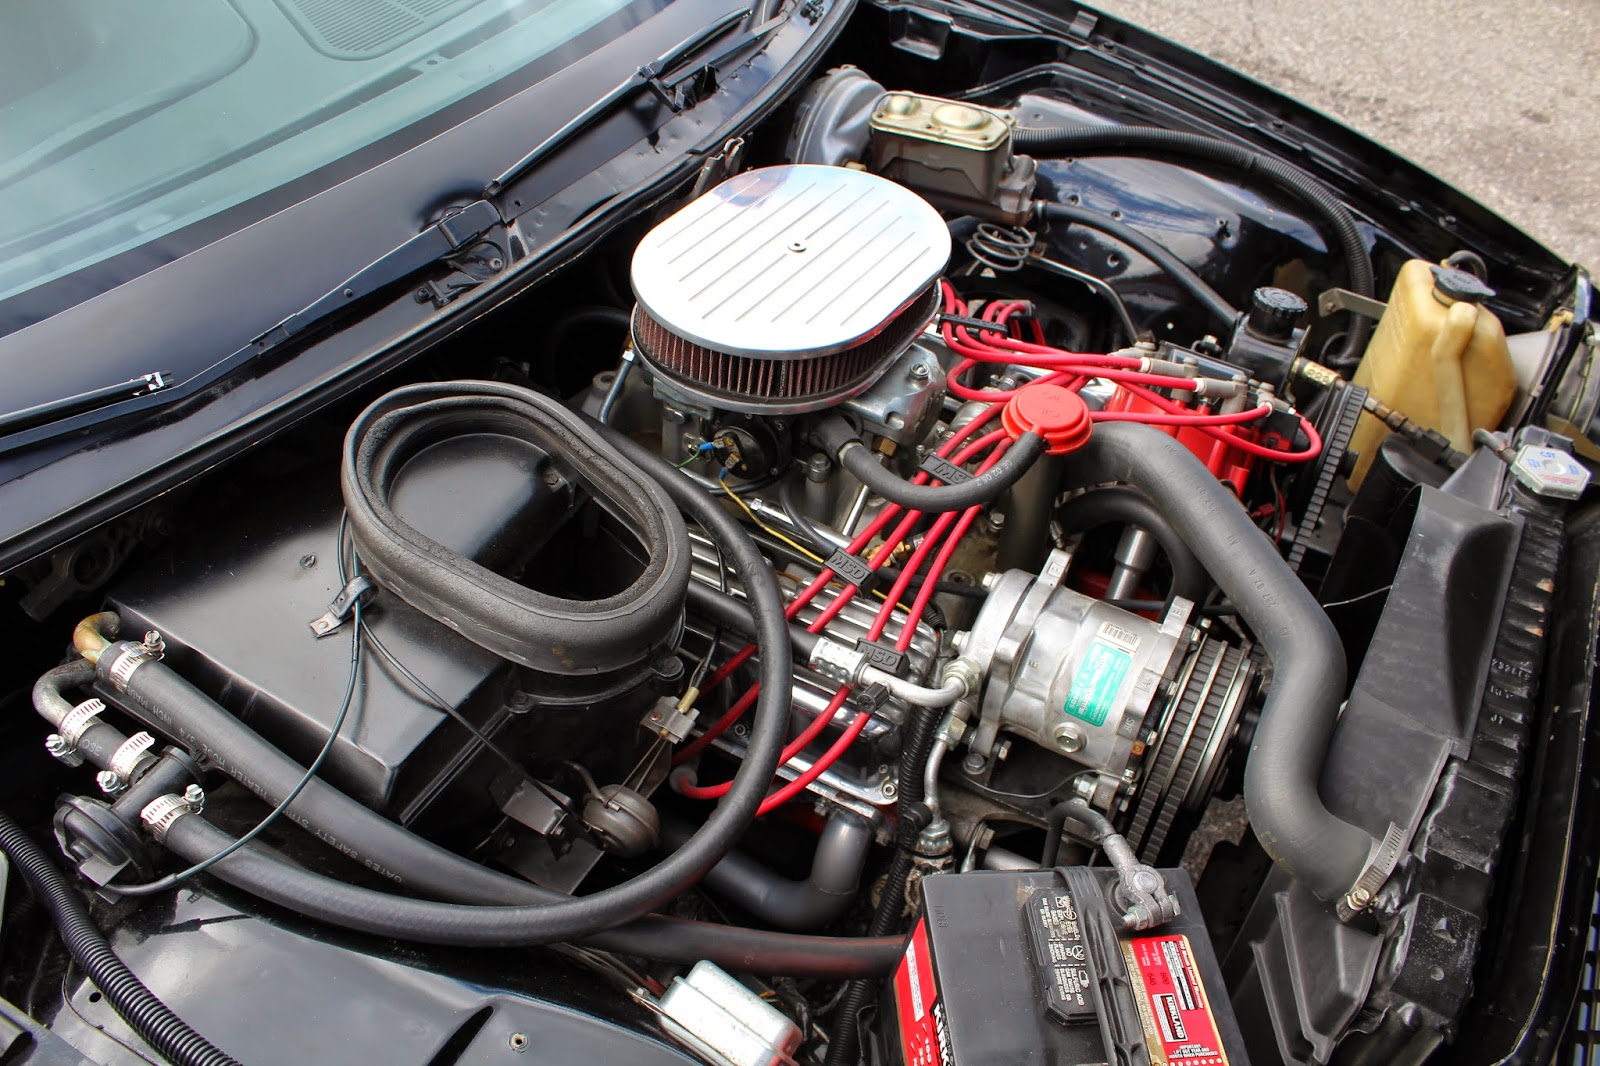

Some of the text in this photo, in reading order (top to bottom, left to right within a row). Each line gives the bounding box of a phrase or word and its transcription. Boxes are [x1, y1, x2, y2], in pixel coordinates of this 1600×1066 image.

[934, 463, 968, 484] MS
[829, 554, 866, 580] MSD
[152, 705, 173, 727] INCH
[272, 797, 310, 829] STRIE
[315, 828, 359, 860] SAFETY
[1065, 948, 1072, 956] NO
[1070, 968, 1084, 1005] SULFURIC ACID
[1165, 997, 1185, 1038] KIRKLAND
[924, 1037, 932, 1063] 100
